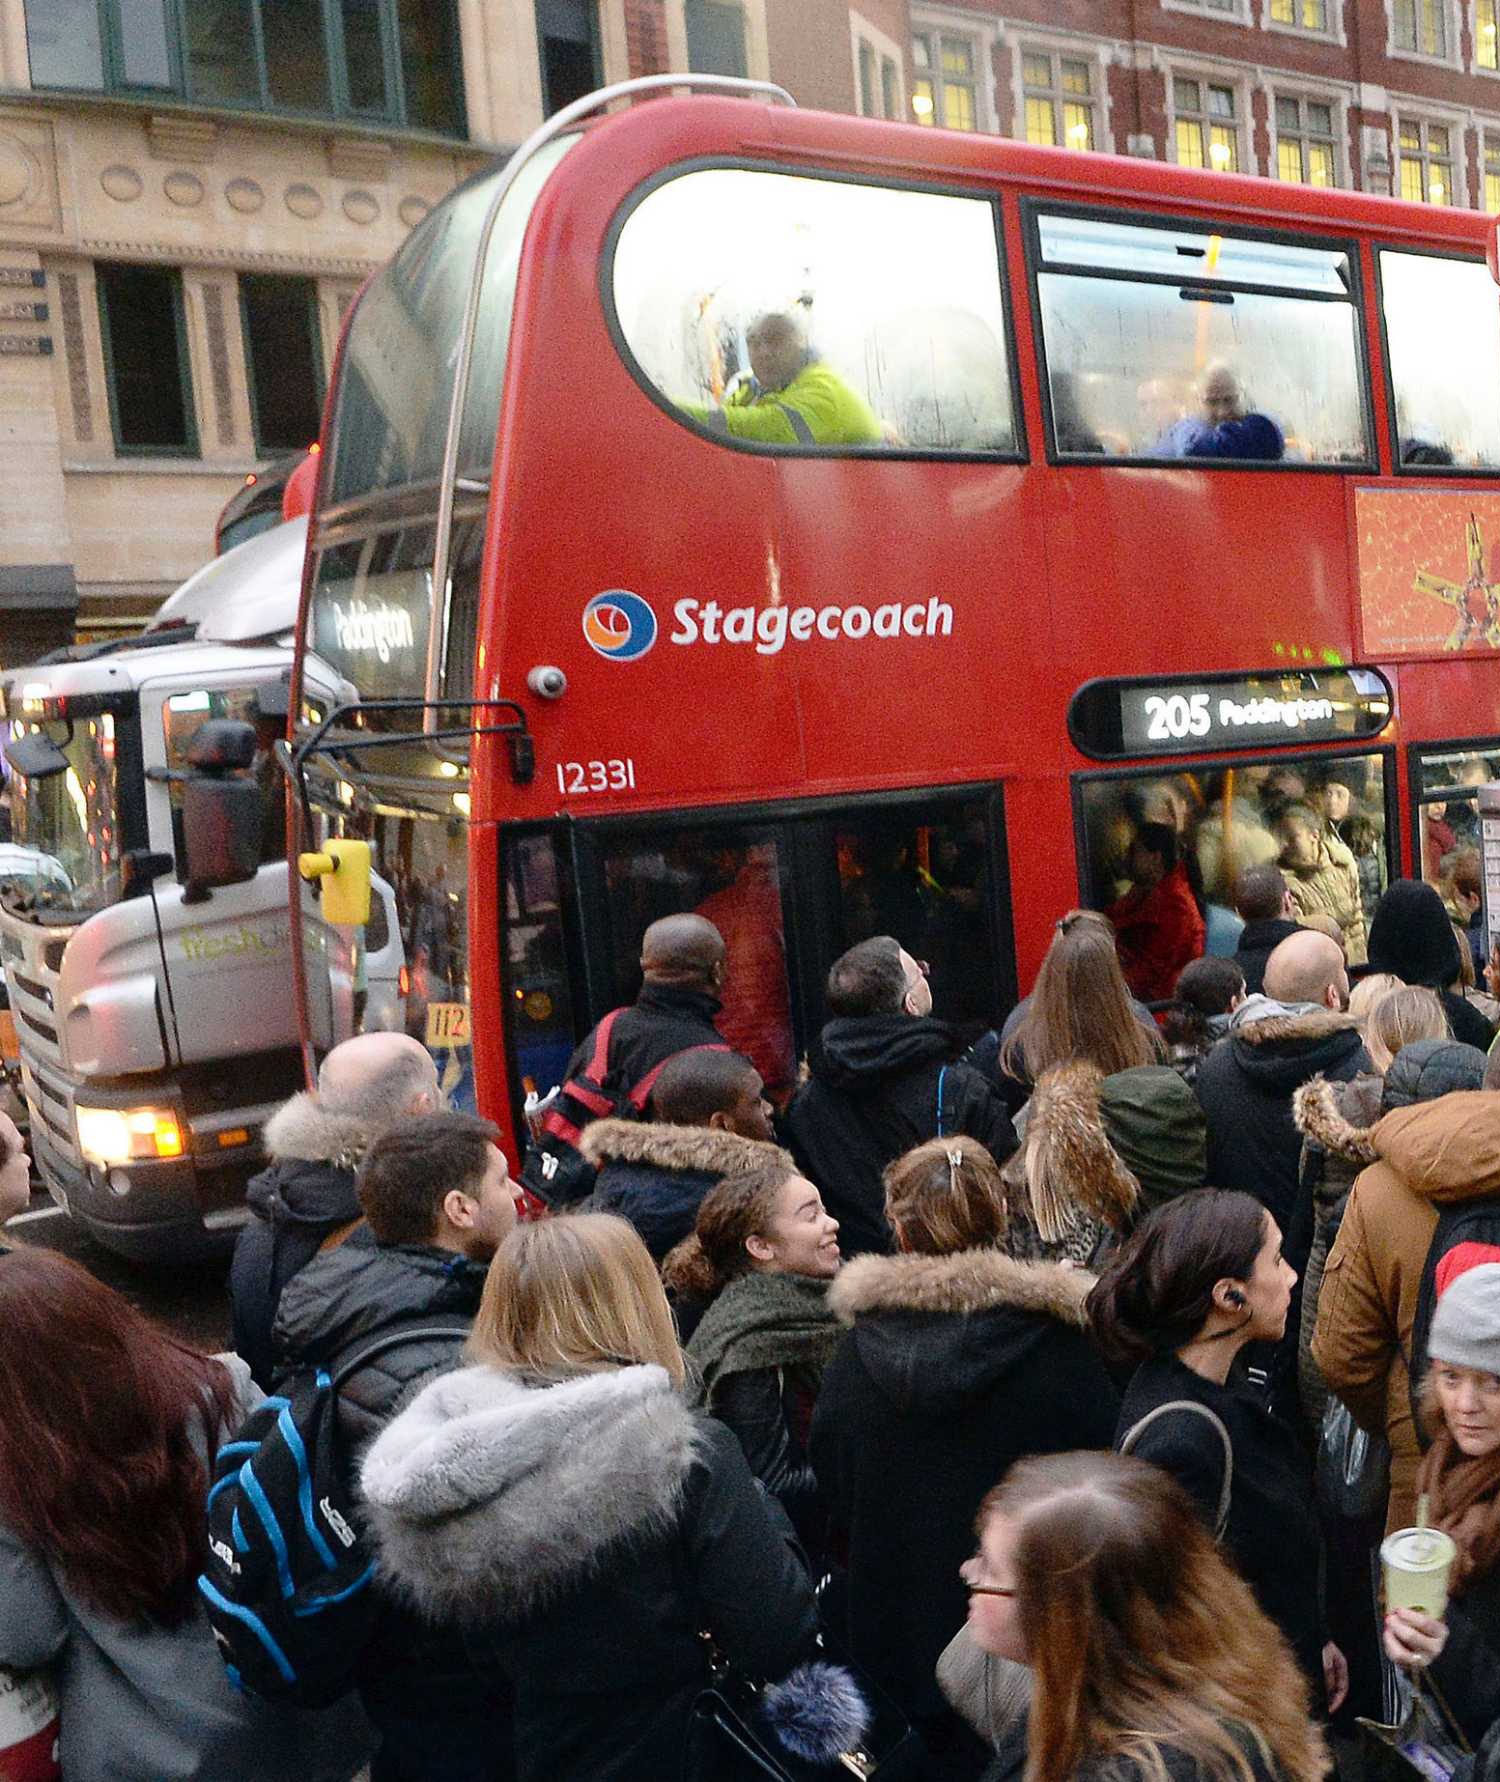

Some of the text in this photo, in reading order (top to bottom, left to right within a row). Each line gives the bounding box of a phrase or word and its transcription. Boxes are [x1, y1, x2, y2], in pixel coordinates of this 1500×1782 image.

[333, 598, 415, 664] Paddington
[670, 596, 954, 655] Stagecoach
[1144, 693, 1333, 740] 205 Paddington
[556, 758, 635, 794] 12331
